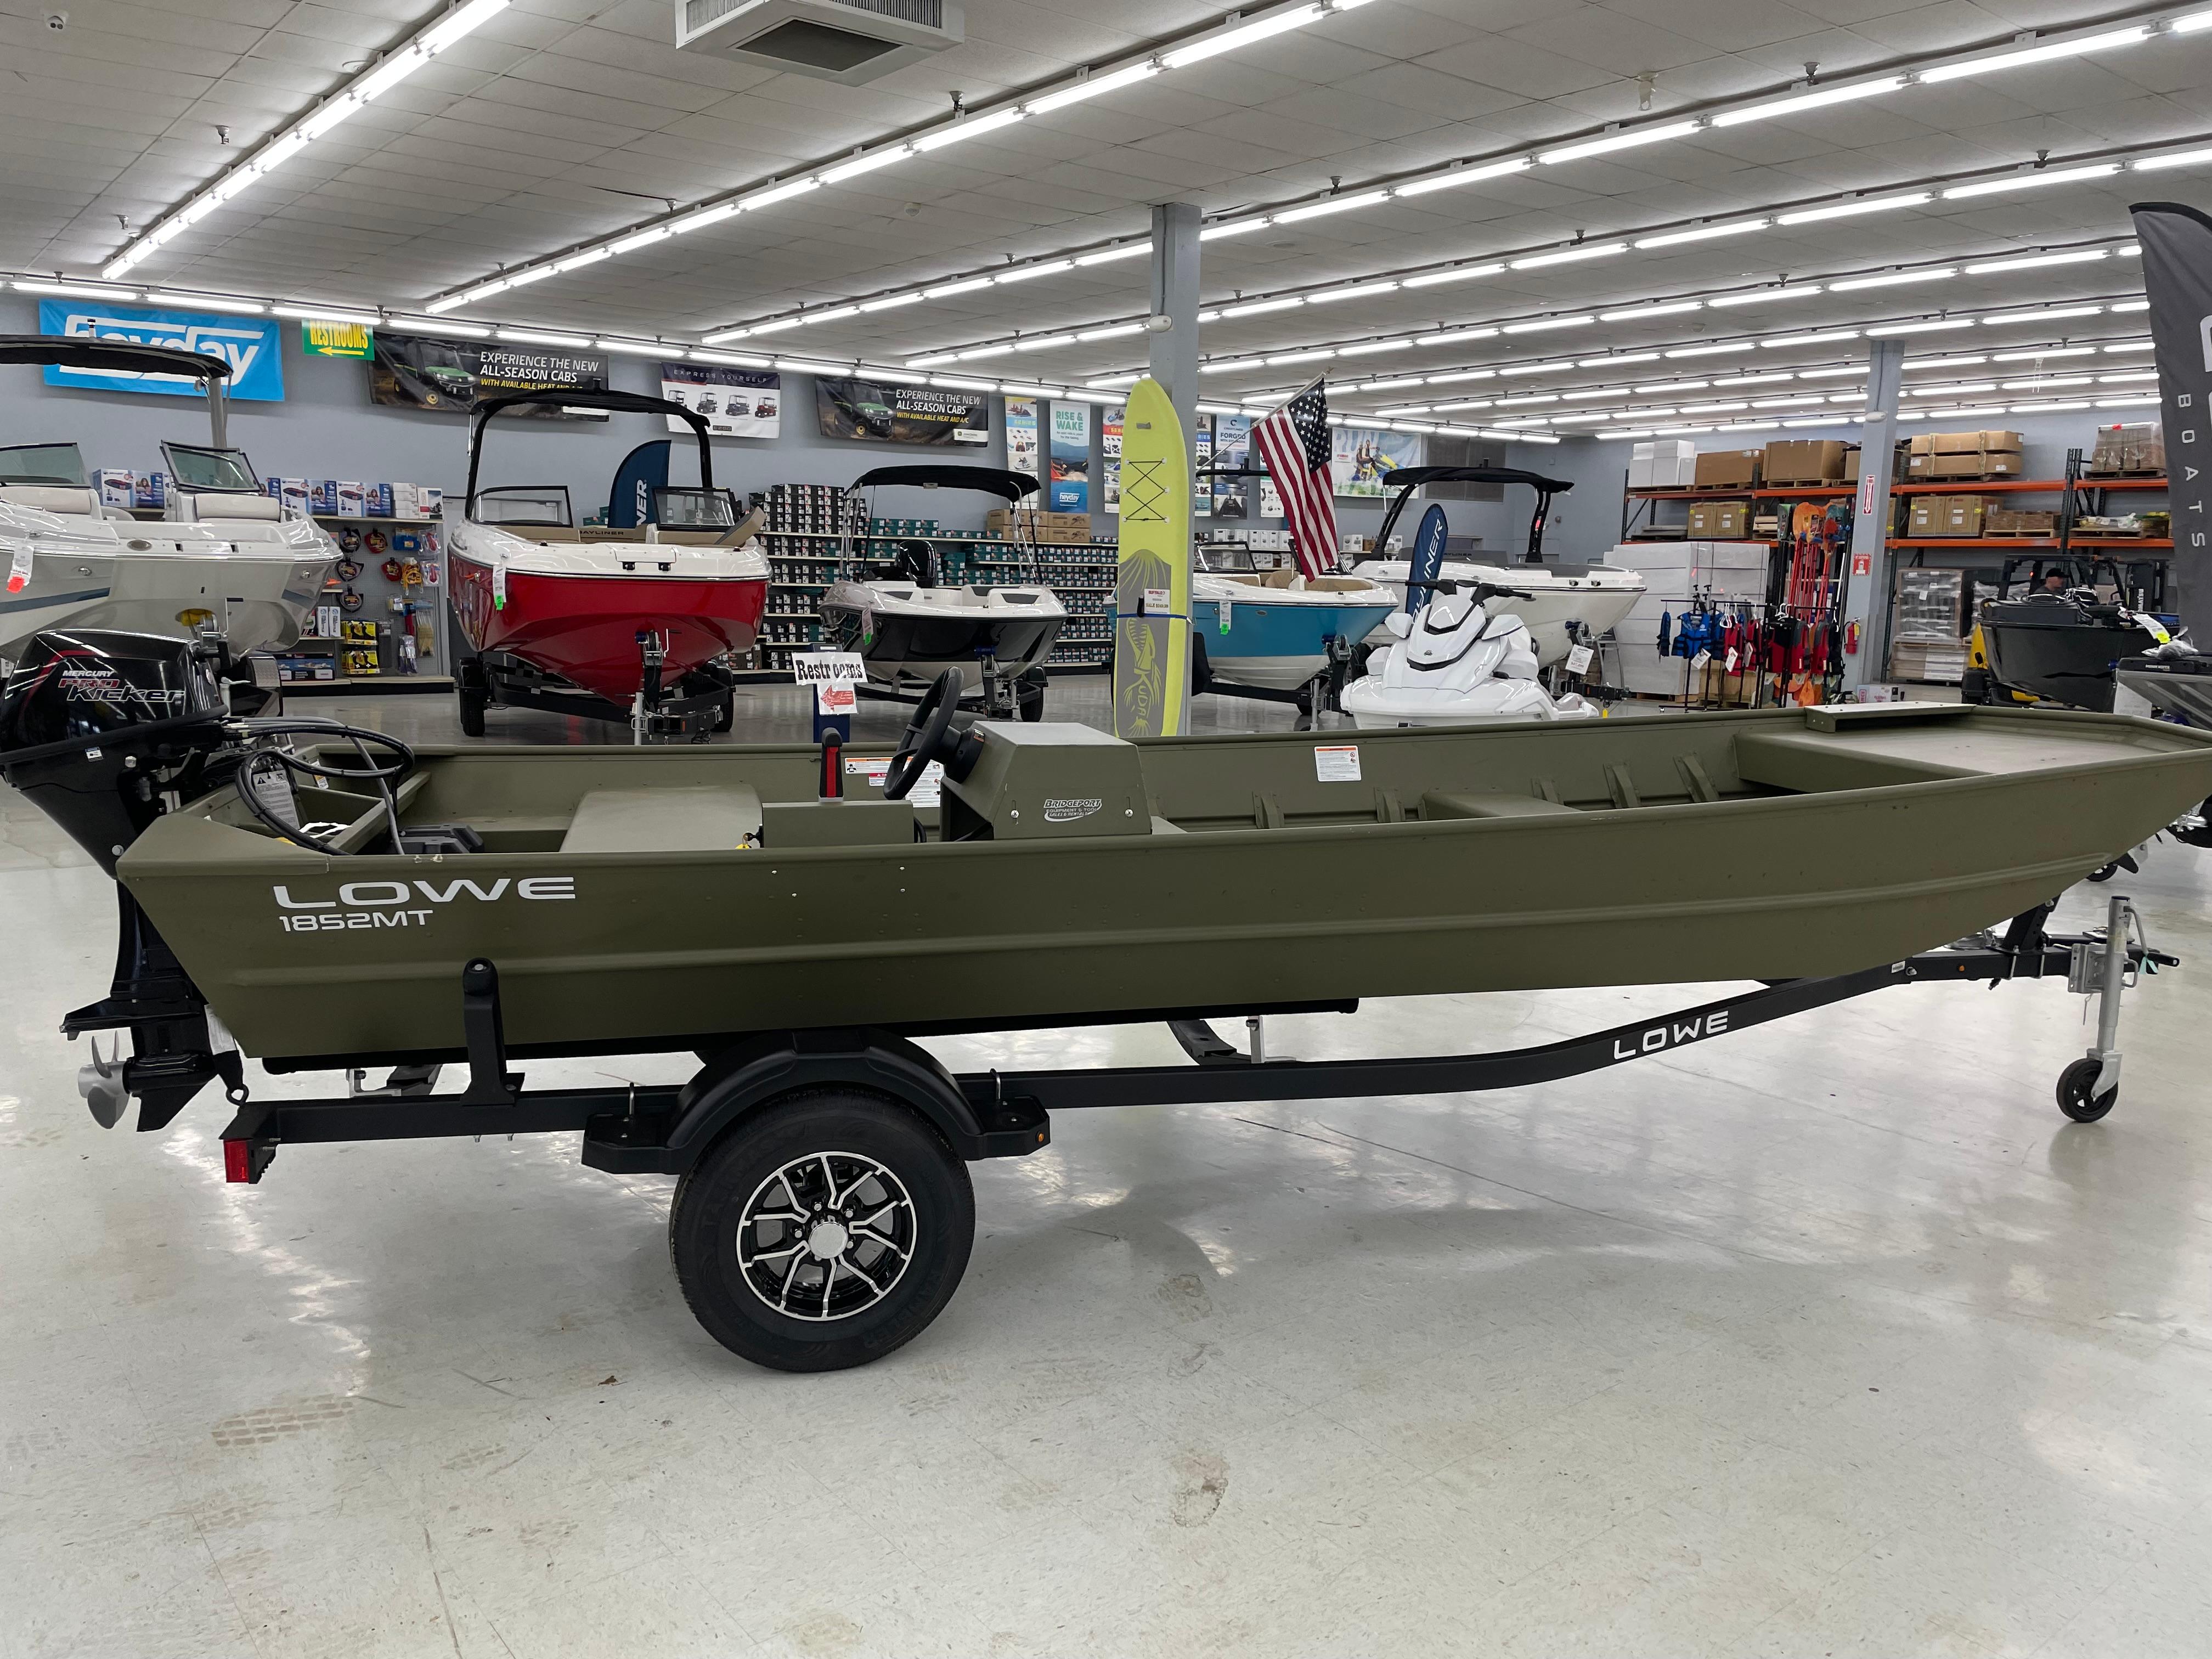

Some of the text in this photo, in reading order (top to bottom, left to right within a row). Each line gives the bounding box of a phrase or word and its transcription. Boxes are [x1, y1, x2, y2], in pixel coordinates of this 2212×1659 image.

[309, 320, 369, 349] RESTROOMS
[64, 315, 264, 386] hday
[480, 351, 600, 372] EXPERIENCE THE NEW
[479, 364, 578, 383] ALL-SEASON CABS
[674, 369, 768, 383] EXPRESS YOURSELF
[481, 378, 500, 387] WITH
[500, 380, 537, 390] AVAILABLE
[896, 388, 983, 405] EXPERIENCE THE NEW
[896, 400, 967, 415] ALL-SEASON CABS
[910, 413, 936, 421] AVAILABLE
[1056, 410, 1084, 422] RISE &
[1056, 419, 1084, 432] WAKE
[2177, 393, 2206, 548] BOATS
[1059, 492, 1080, 503] heyday
[58, 678, 120, 688] PRO
[1043, 799, 1102, 809] BRIDGEPORT
[273, 877, 576, 909] LOWE
[279, 910, 434, 932] 1852MT
[1613, 1010, 1729, 1060] LOWE
